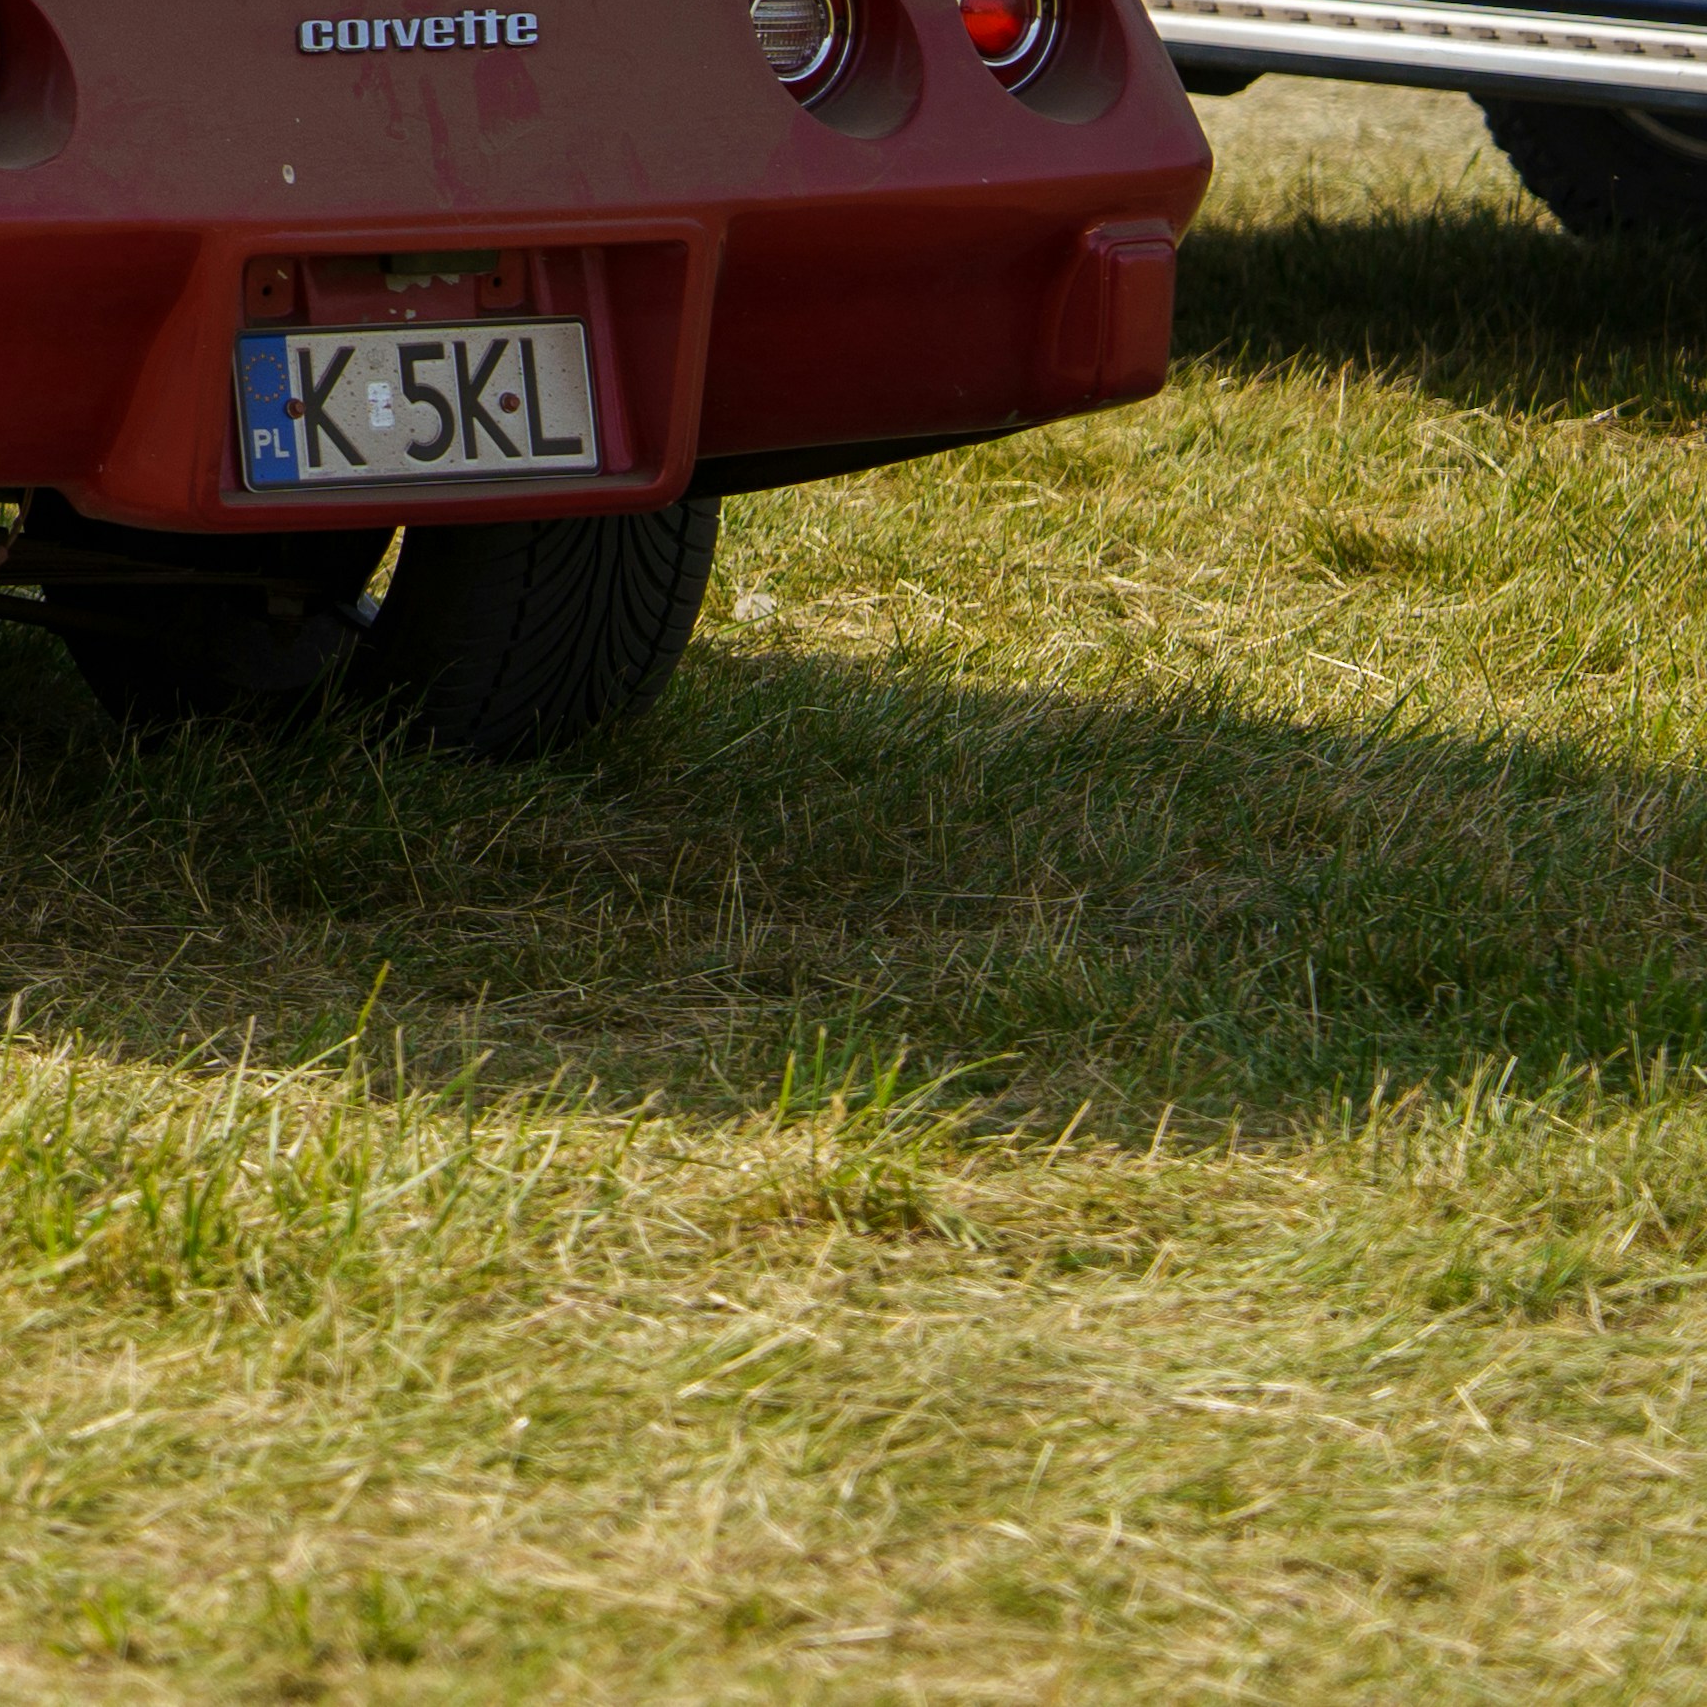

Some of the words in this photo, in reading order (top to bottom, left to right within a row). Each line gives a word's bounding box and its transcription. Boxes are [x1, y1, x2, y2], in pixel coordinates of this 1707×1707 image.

[298, 9, 540, 53] corvette
[298, 346, 367, 468] K
[396, 338, 583, 463] 5KL
[252, 428, 291, 459] PL
